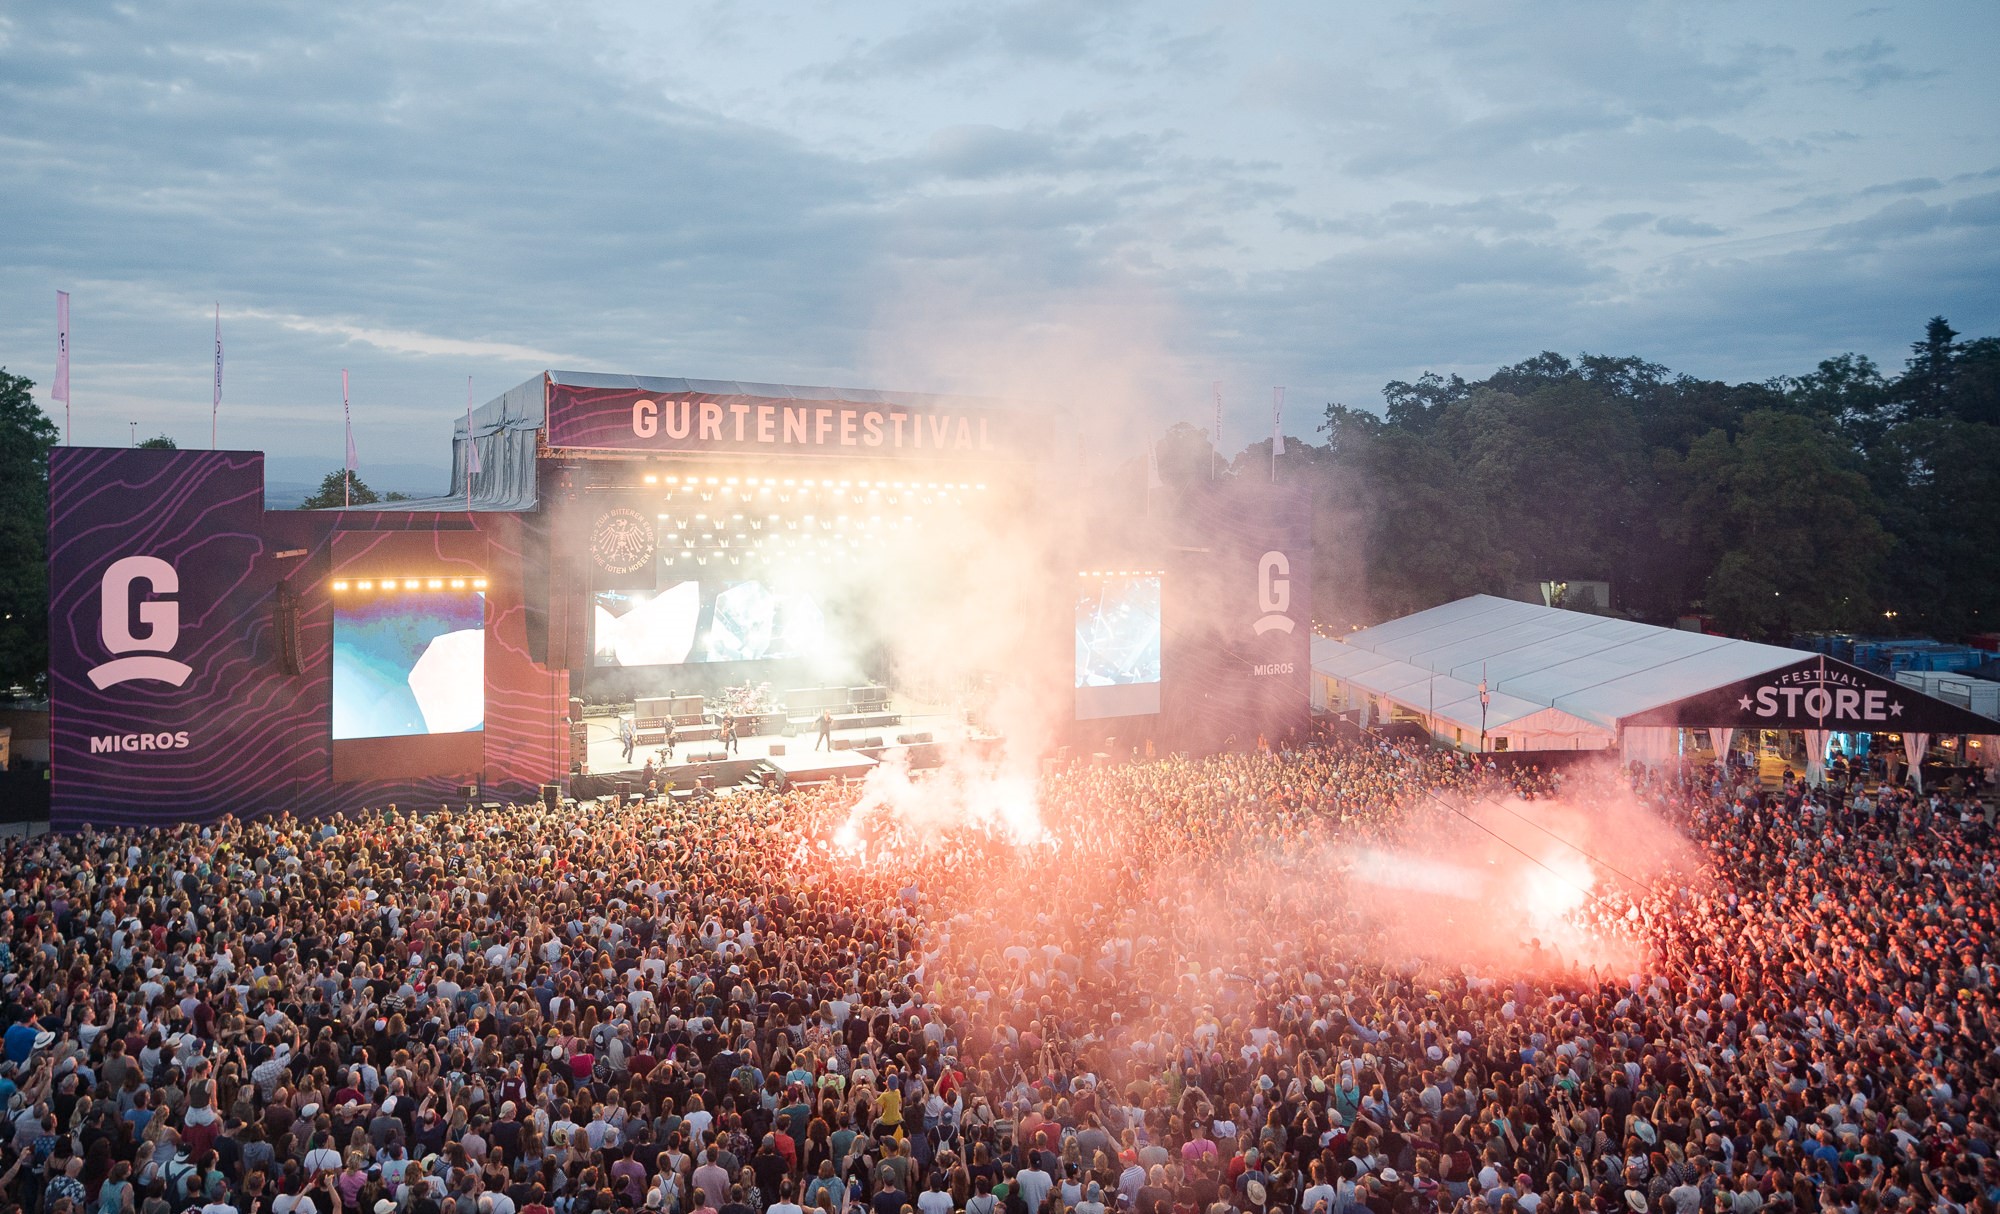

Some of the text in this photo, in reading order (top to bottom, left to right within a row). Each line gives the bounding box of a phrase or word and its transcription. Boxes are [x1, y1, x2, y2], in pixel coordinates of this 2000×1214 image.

[632, 399, 995, 451] GURTENFESTIVAL
[610, 508, 645, 522] BITTEREN
[642, 521, 655, 542] ENDE
[593, 552, 651, 574] DIE TOTEN HOSEN
[1258, 550, 1290, 613] G
[101, 555, 179, 655] G
[1254, 663, 1294, 676] MIGROS
[1782, 670, 1858, 687] FESTIVAL
[1756, 685, 1887, 721] STORE
[90, 731, 190, 754] MIGROS
